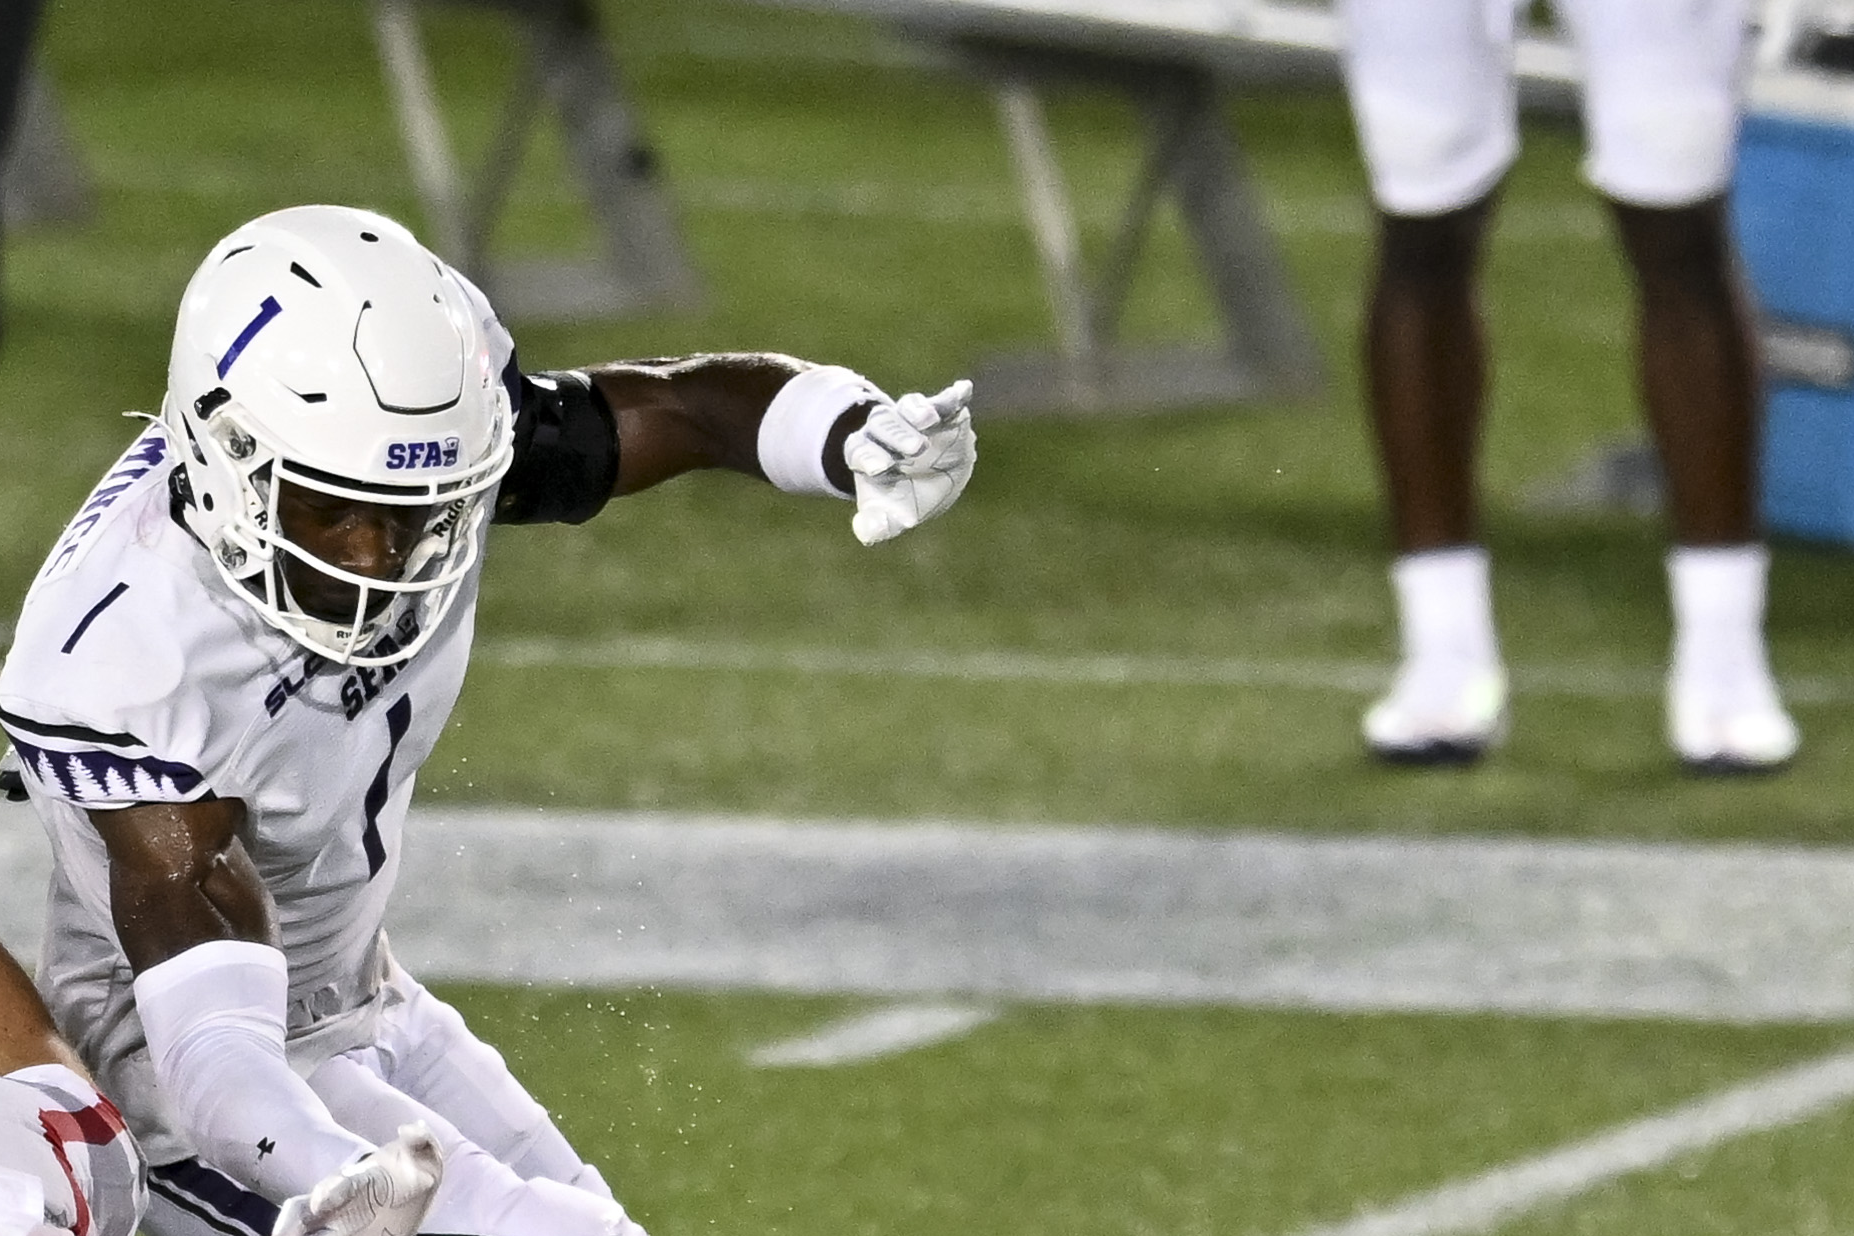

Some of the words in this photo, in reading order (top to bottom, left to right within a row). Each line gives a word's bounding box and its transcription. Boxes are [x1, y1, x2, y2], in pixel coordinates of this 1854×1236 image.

[217, 295, 283, 380] 1
[386, 441, 443, 470] SFA
[61, 582, 130, 654] 1
